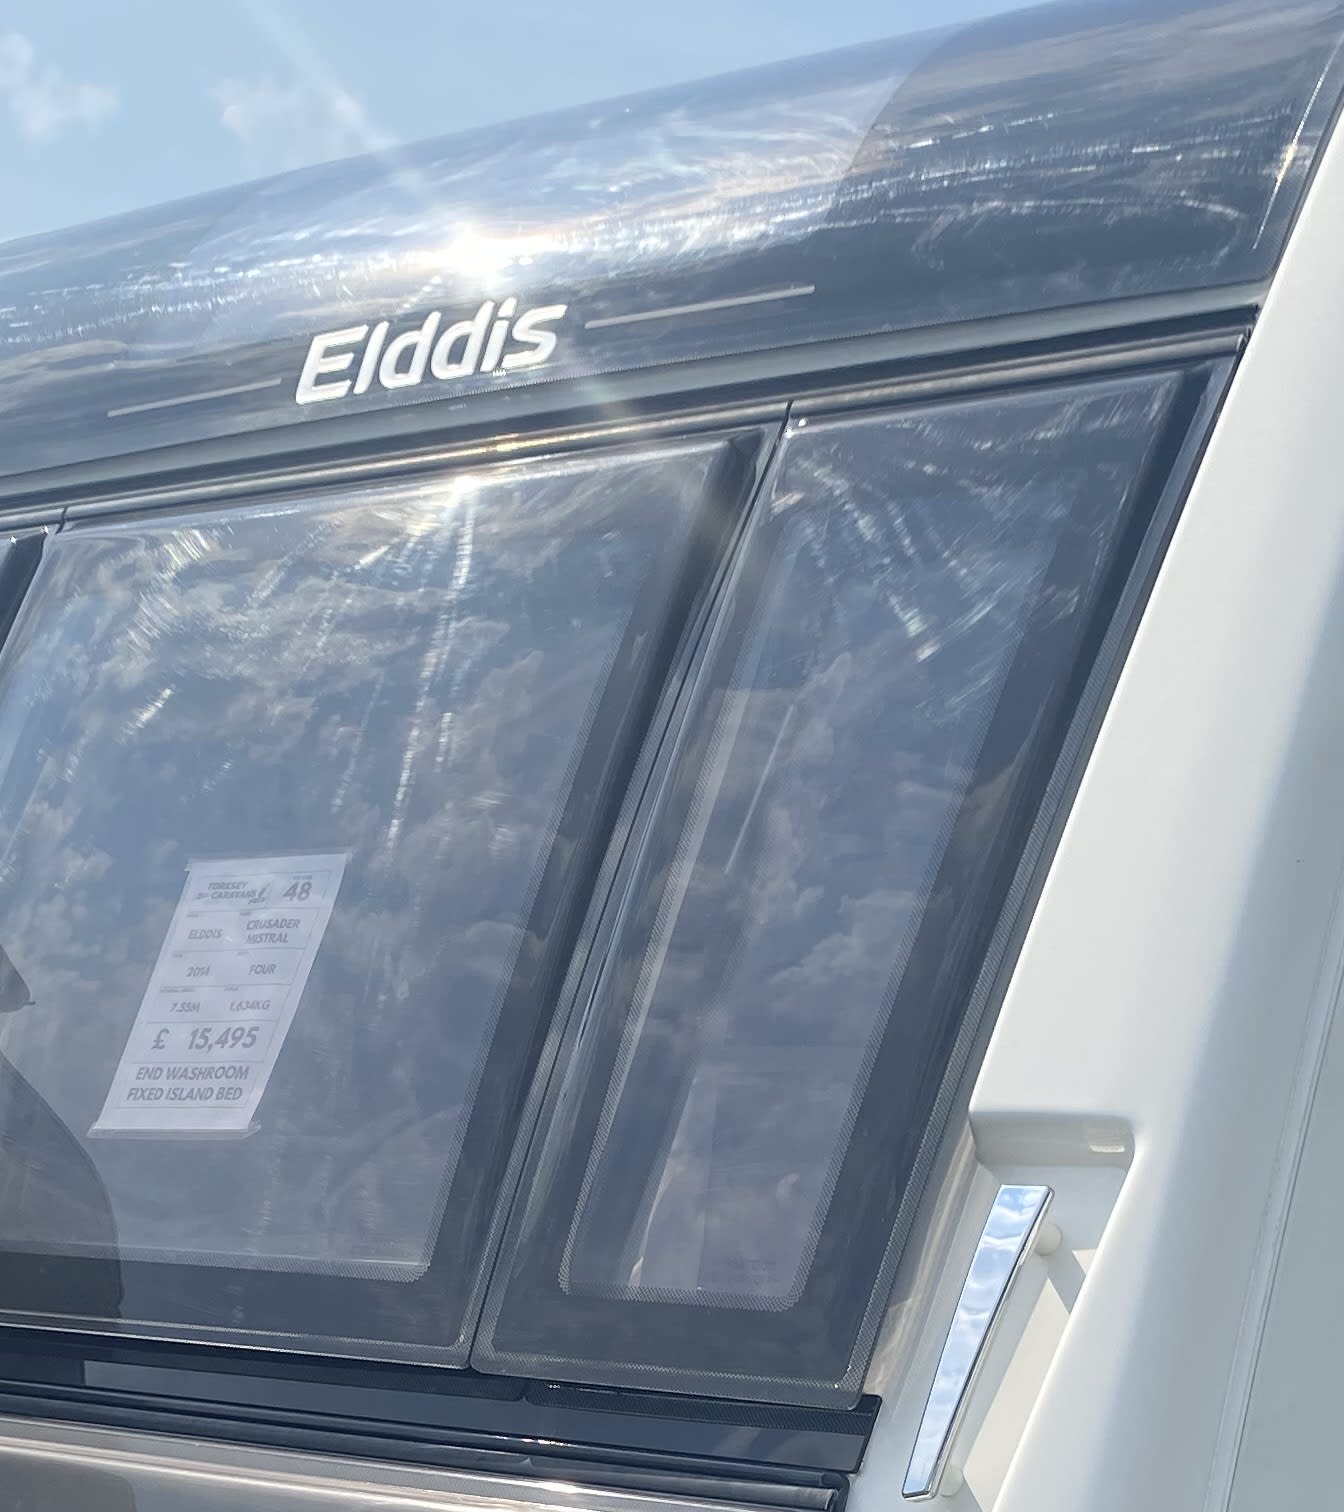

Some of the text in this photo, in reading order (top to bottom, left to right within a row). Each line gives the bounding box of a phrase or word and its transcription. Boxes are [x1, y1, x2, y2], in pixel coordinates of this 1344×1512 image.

[295, 297, 568, 405] Elddis
[282, 881, 313, 901] 48
[246, 919, 301, 930] CRUSADER
[246, 932, 288, 944] MISTRAL
[248, 964, 276, 976] FOUR
[152, 1026, 259, 1053] £ 15,495
[136, 1065, 249, 1081] END WASHROOM
[127, 1086, 243, 1101] FIXED ISLAND BED
